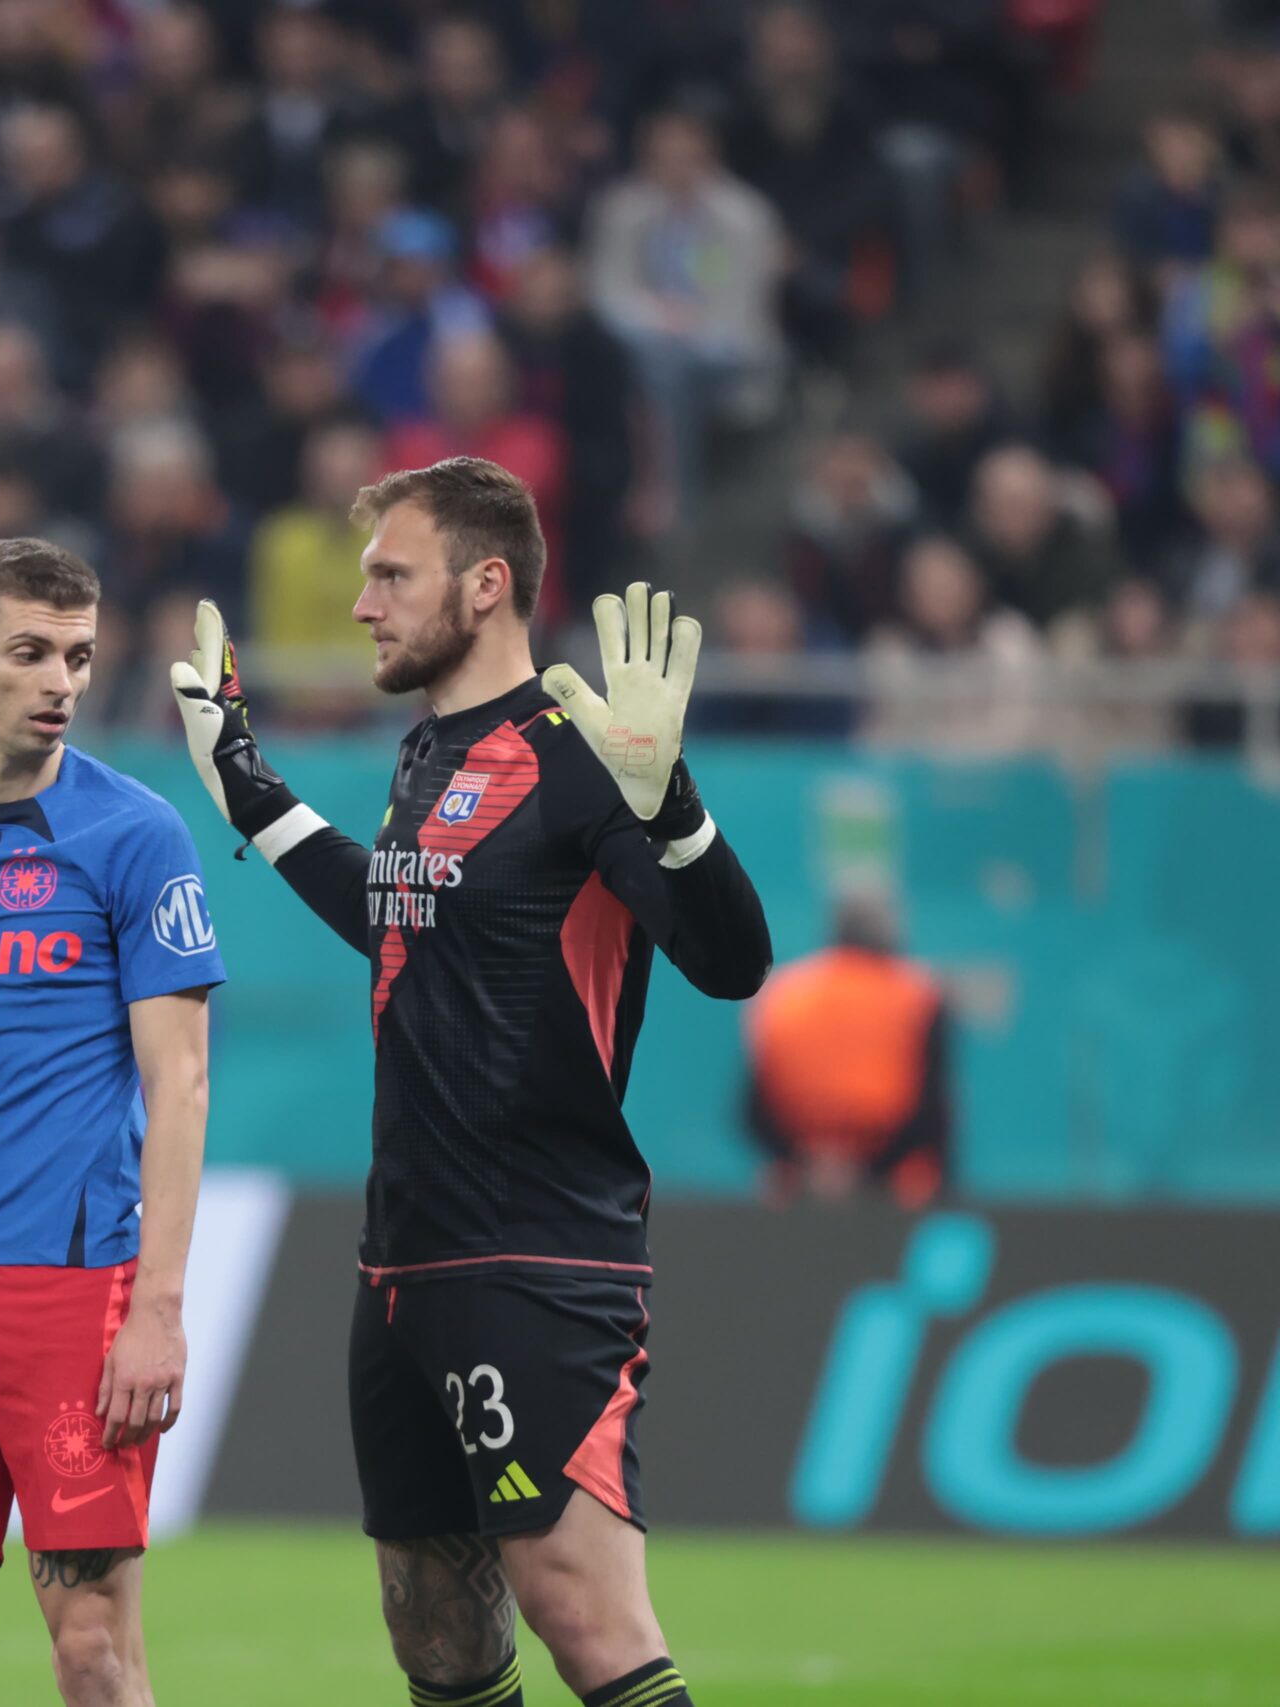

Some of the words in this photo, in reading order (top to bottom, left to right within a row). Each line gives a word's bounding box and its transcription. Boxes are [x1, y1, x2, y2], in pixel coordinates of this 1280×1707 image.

[444, 793, 473, 817] OL
[367, 841, 463, 888] mirates
[384, 892, 436, 928] BETTER
[446, 1364, 514, 1455] 23
